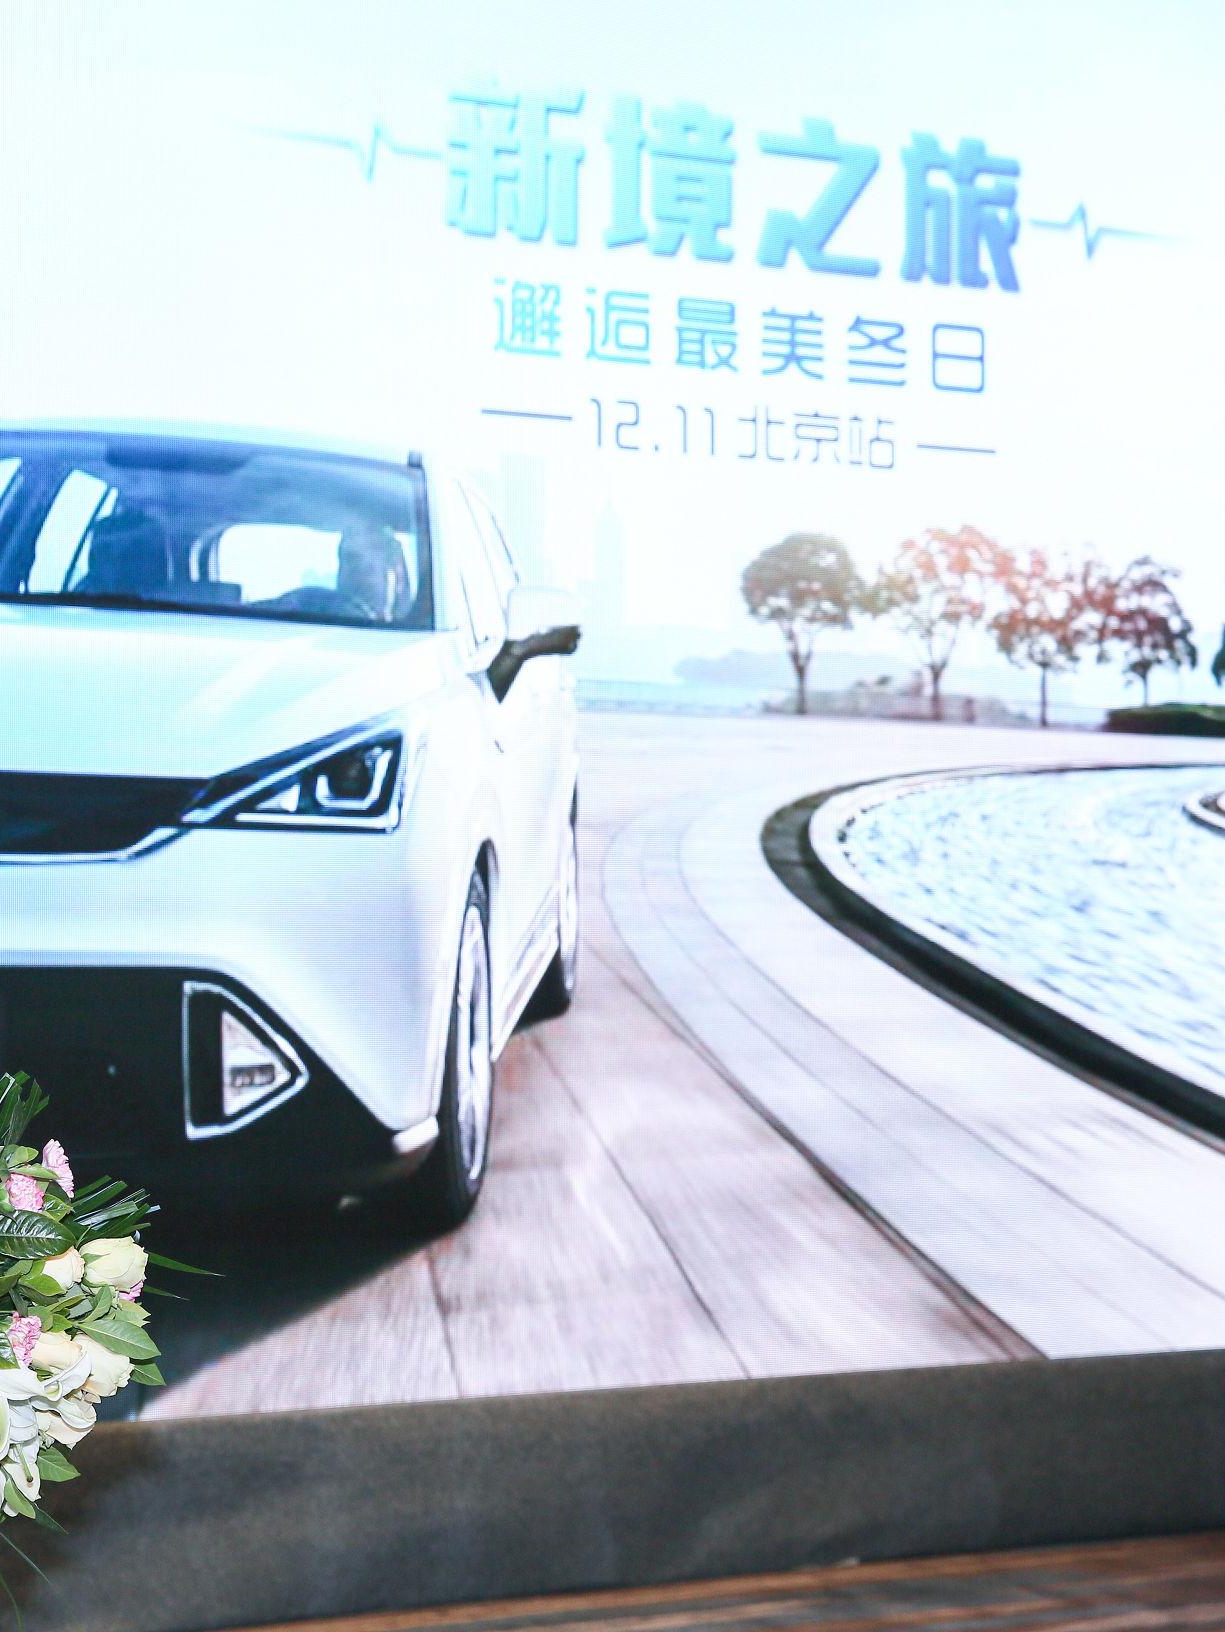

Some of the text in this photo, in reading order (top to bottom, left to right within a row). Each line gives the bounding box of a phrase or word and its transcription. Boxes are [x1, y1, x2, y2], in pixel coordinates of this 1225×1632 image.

[444, 78, 1022, 294] 新境之旅
[493, 276, 986, 395] 邂逅最美冬日
